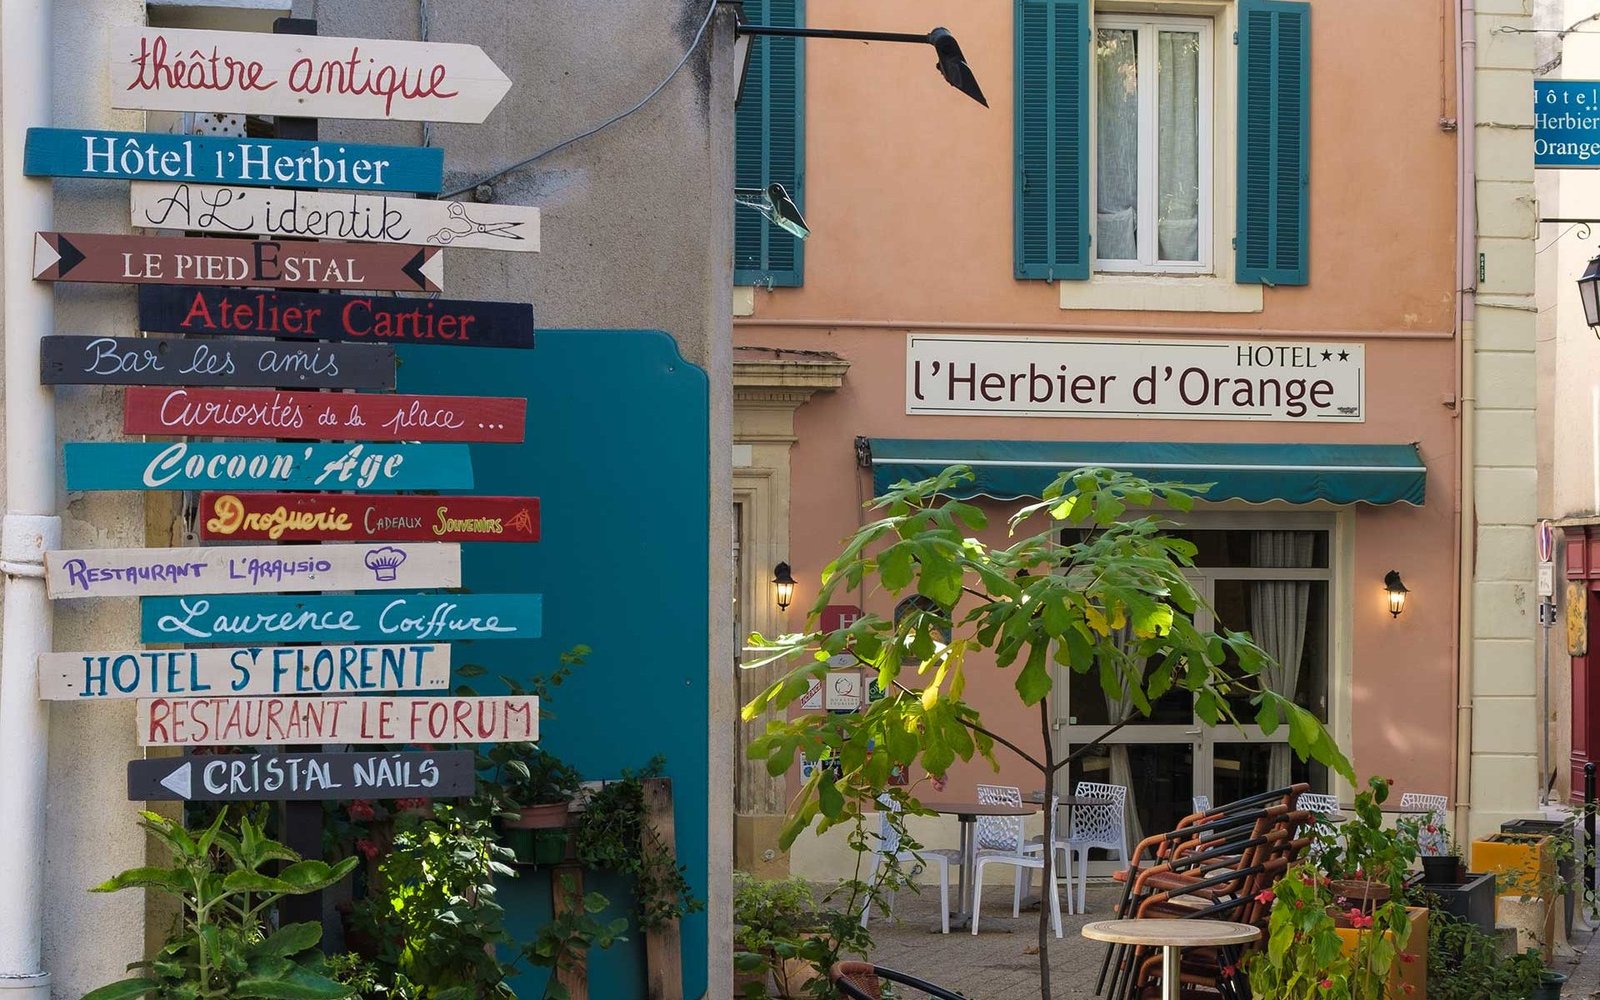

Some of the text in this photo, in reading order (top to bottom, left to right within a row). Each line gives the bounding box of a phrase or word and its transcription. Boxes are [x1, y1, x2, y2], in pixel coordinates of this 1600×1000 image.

[127, 36, 459, 117] théâtre antique
[1534, 112, 1600, 130] Herbier
[82, 136, 193, 178] Hôtel
[1534, 138, 1600, 160] Orange
[122, 252, 163, 279] LE
[180, 291, 476, 341] Atelier Cartier
[84, 338, 340, 377] Bar les amis
[1236, 345, 1317, 368] HOTEL
[913, 360, 1335, 419] l'Herbier d'Orange
[160, 389, 304, 428] Curiosités
[318, 411, 338, 426] de
[344, 404, 366, 427] la
[382, 400, 465, 435] place
[206, 494, 353, 540] Droguerie
[157, 599, 518, 639] Laurence Coiffure
[79, 652, 211, 698] HOTEL
[148, 698, 533, 743] RESTAURANT LE FORUM
